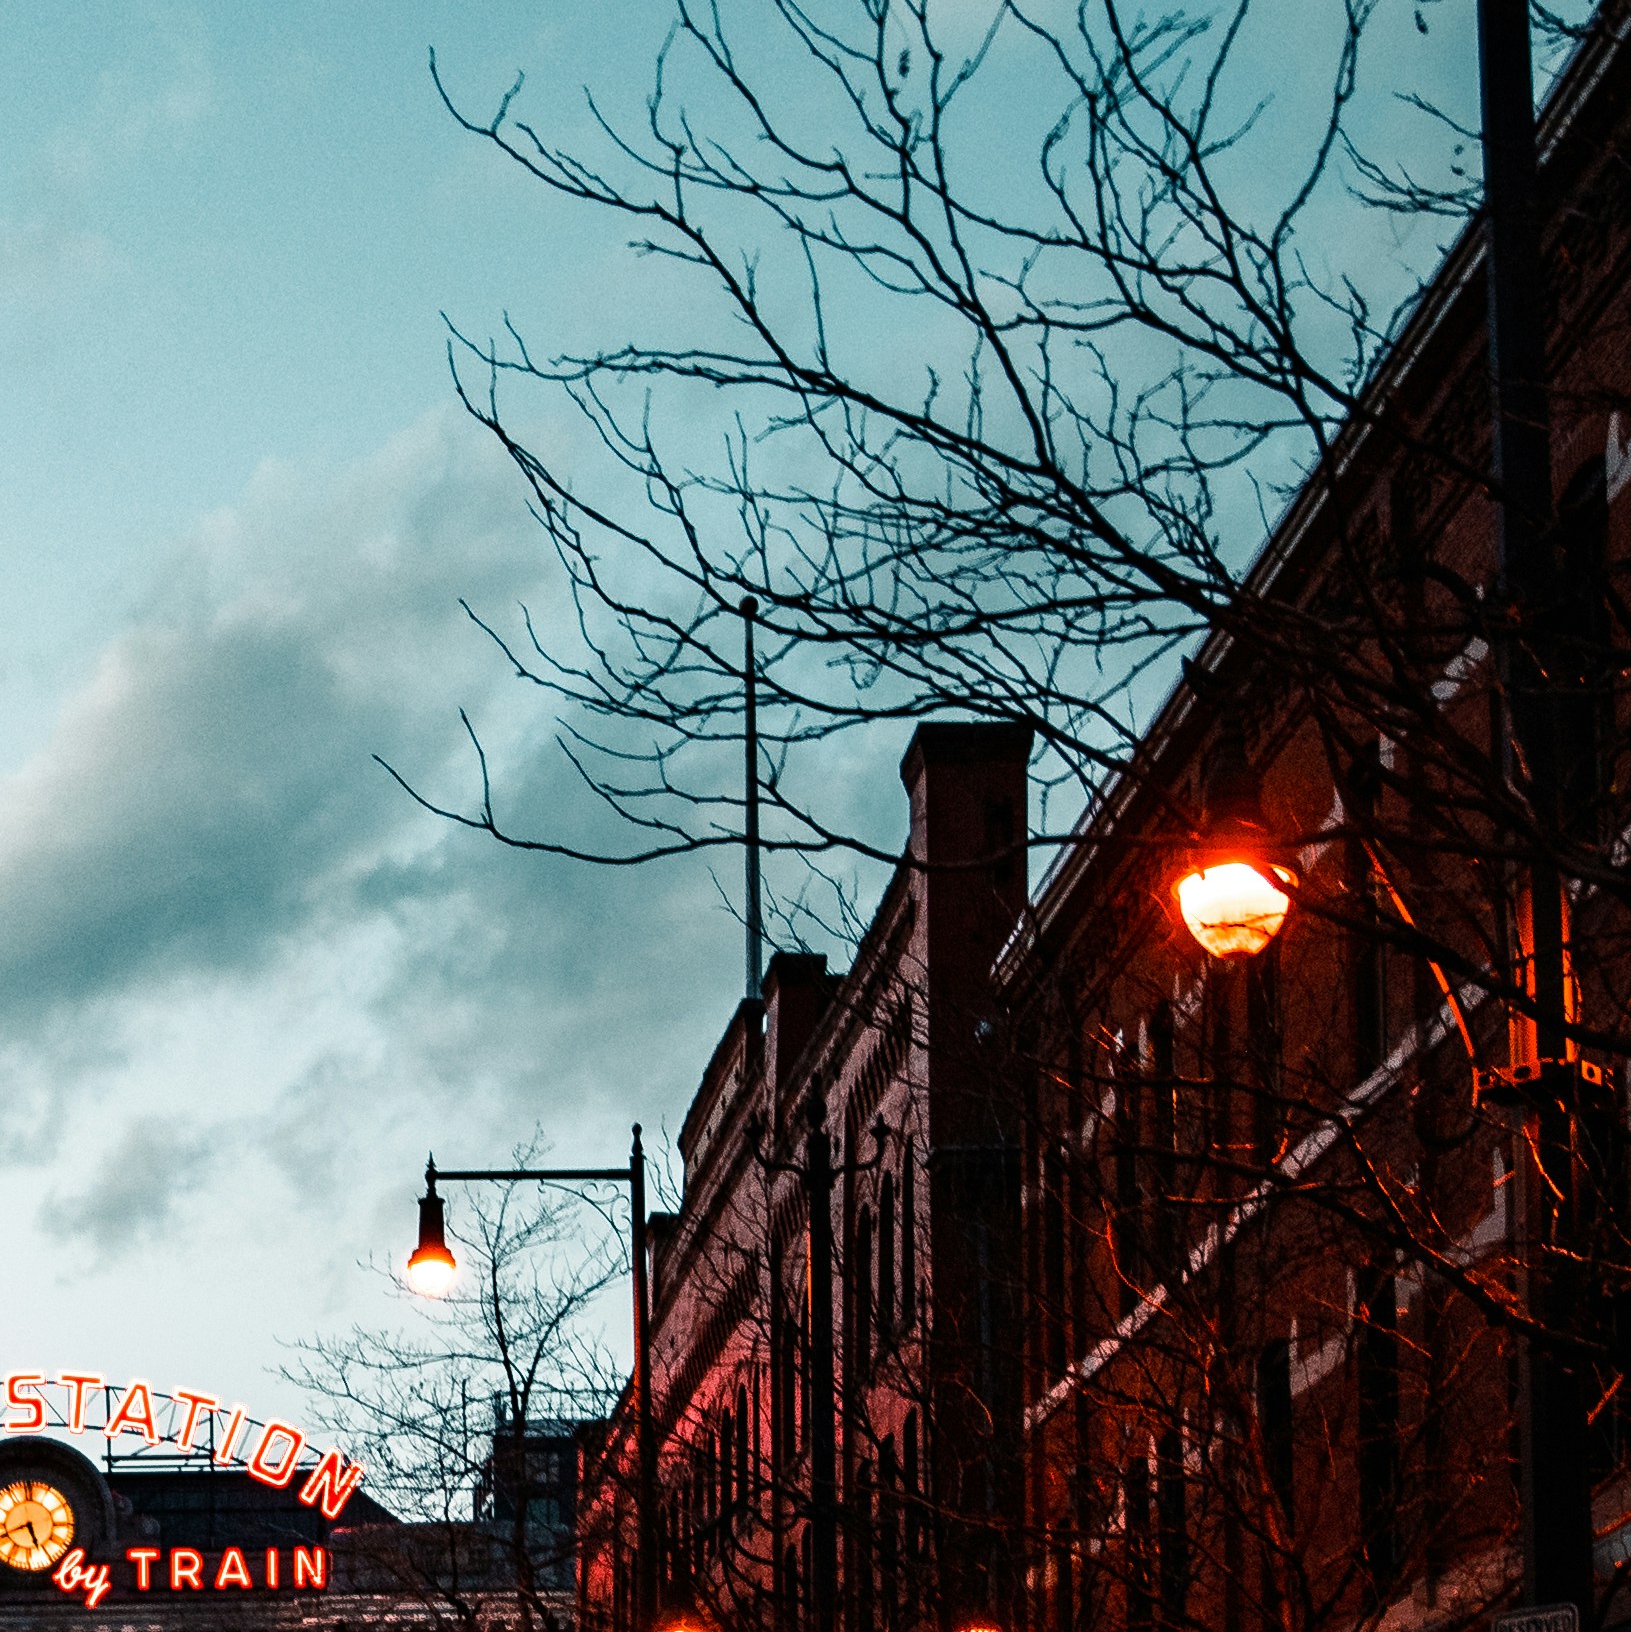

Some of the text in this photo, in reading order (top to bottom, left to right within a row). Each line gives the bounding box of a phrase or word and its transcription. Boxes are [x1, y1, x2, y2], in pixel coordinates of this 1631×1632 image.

[4, 1369, 367, 1520] STATION
[52, 1546, 111, 1608] by
[127, 1546, 326, 1592] TRAIN
